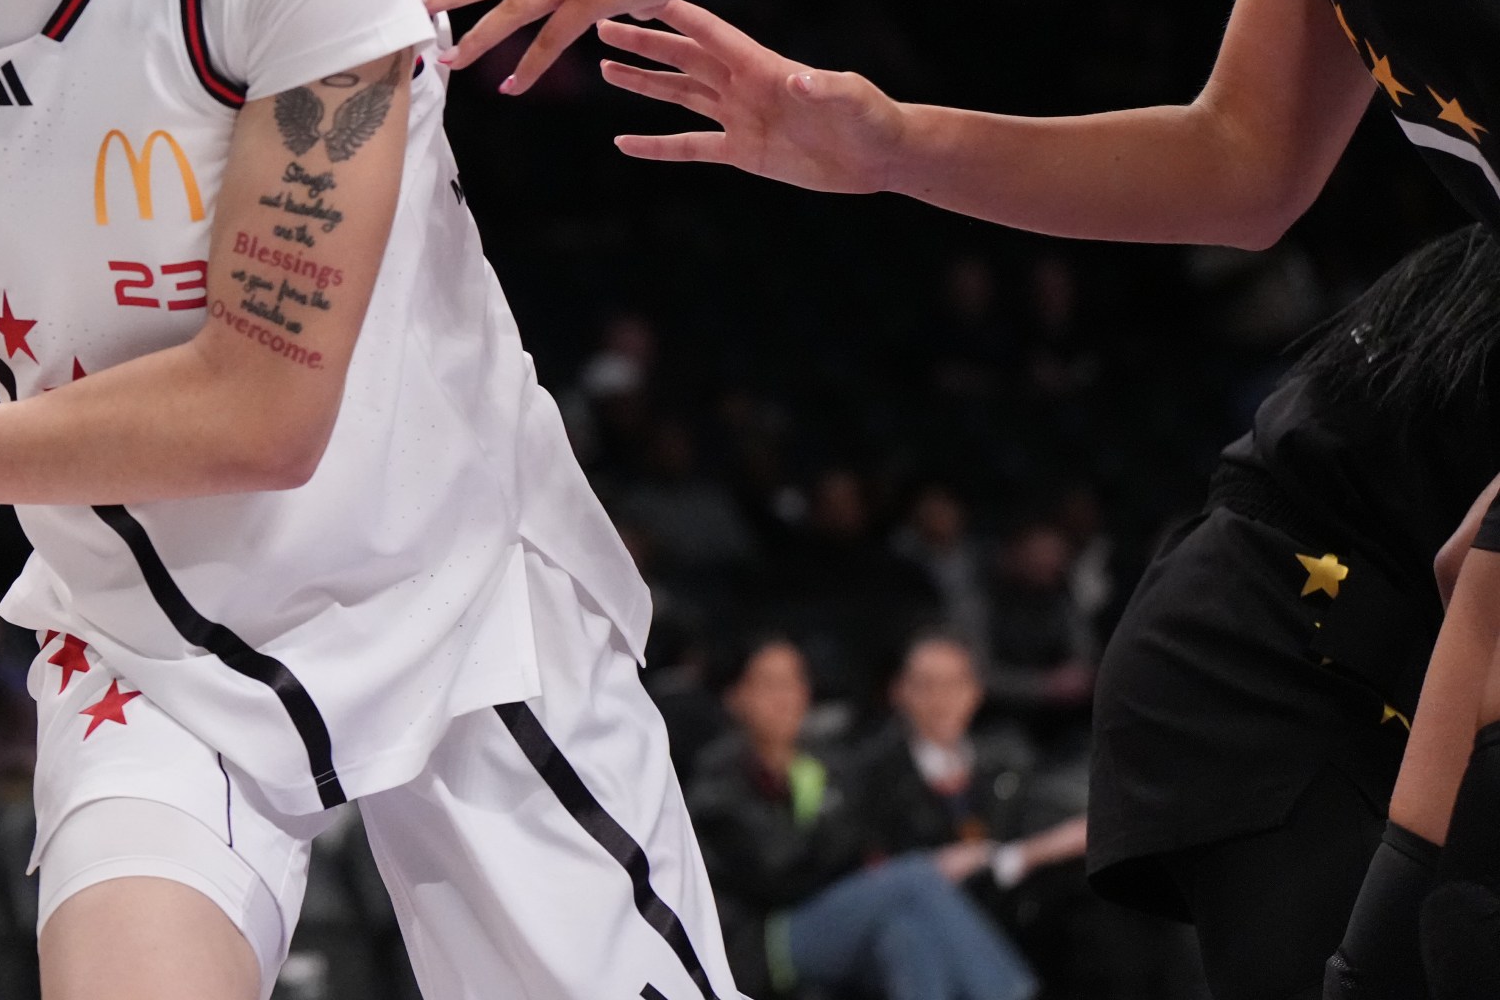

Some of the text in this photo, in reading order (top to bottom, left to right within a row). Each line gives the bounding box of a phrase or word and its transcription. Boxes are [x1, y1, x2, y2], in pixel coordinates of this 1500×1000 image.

[108, 259, 208, 312] 23
[232, 231, 344, 289] Blessings
[209, 300, 325, 370] Overcome.
